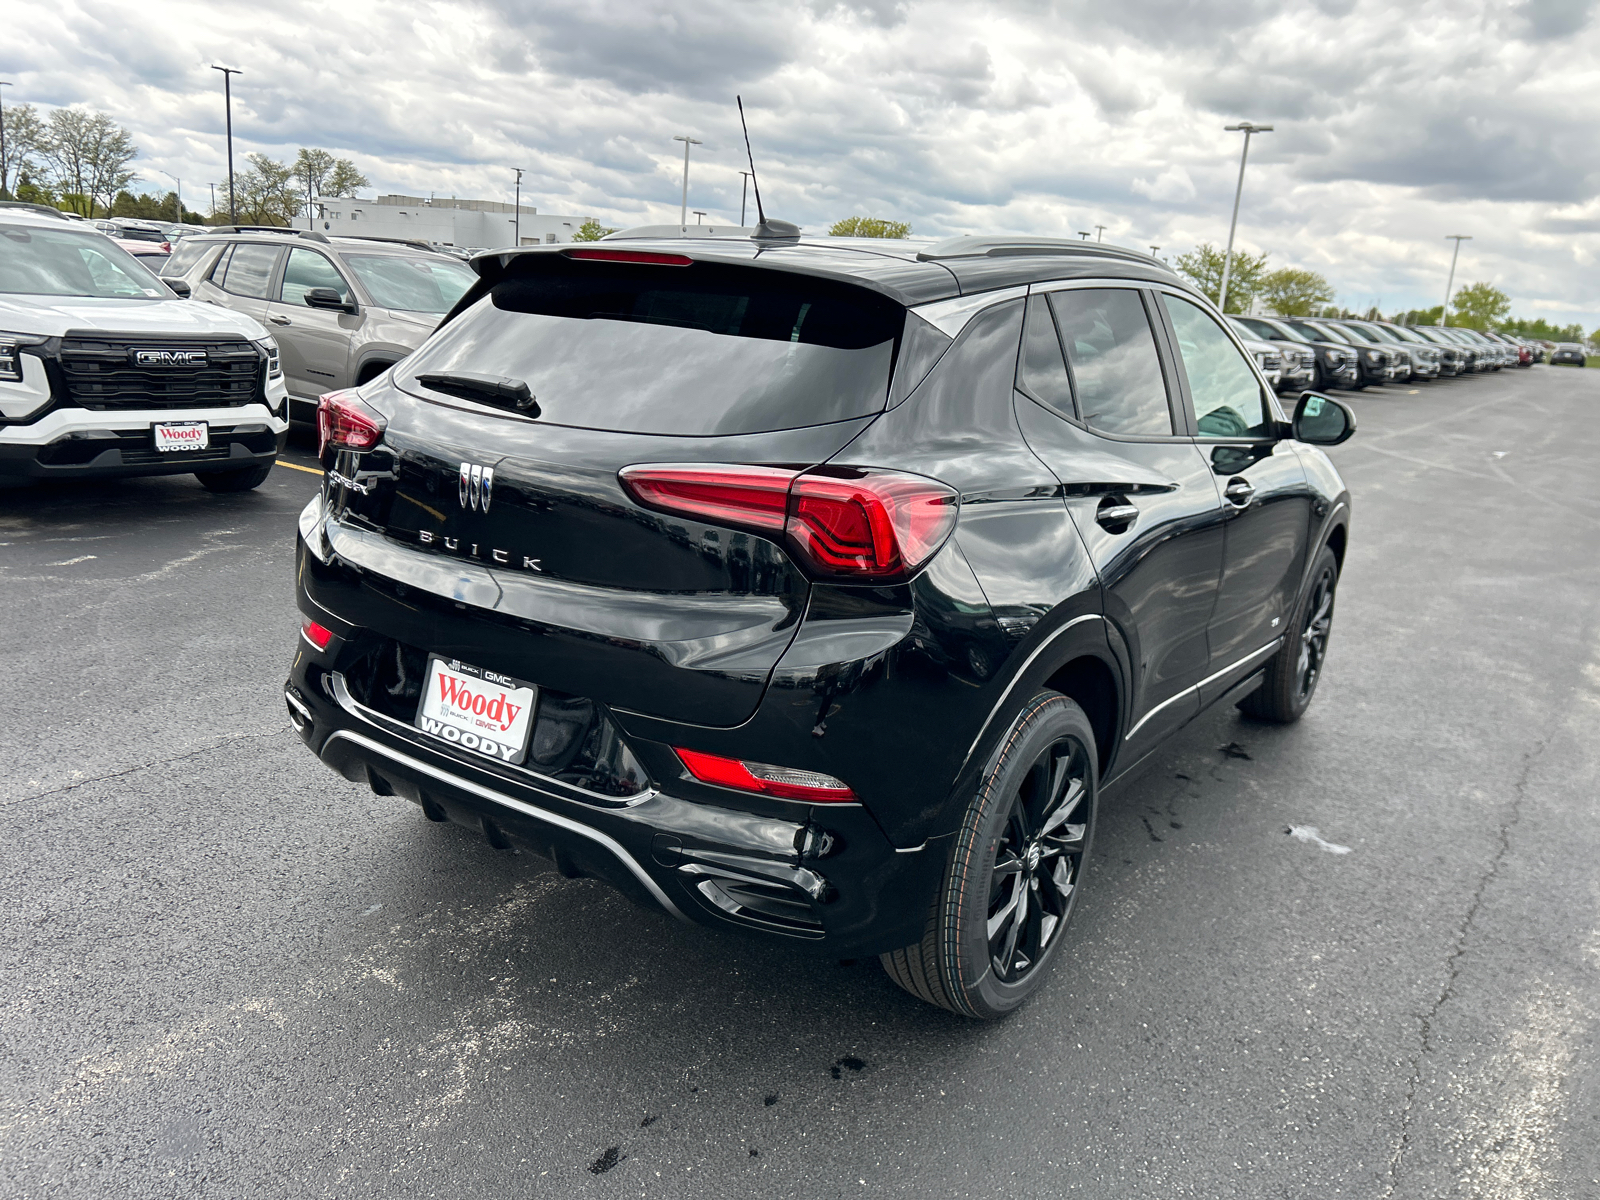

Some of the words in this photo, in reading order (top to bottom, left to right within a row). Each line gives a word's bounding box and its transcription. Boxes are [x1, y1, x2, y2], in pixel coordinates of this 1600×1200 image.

[136, 351, 207, 366] GMC
[159, 428, 203, 441] Woody
[158, 444, 206, 452] WOODY
[419, 530, 542, 571] BUICK
[485, 671, 511, 686] GMC
[438, 673, 522, 732] Woody
[475, 719, 497, 732] GMC
[421, 717, 518, 761] WOODY
